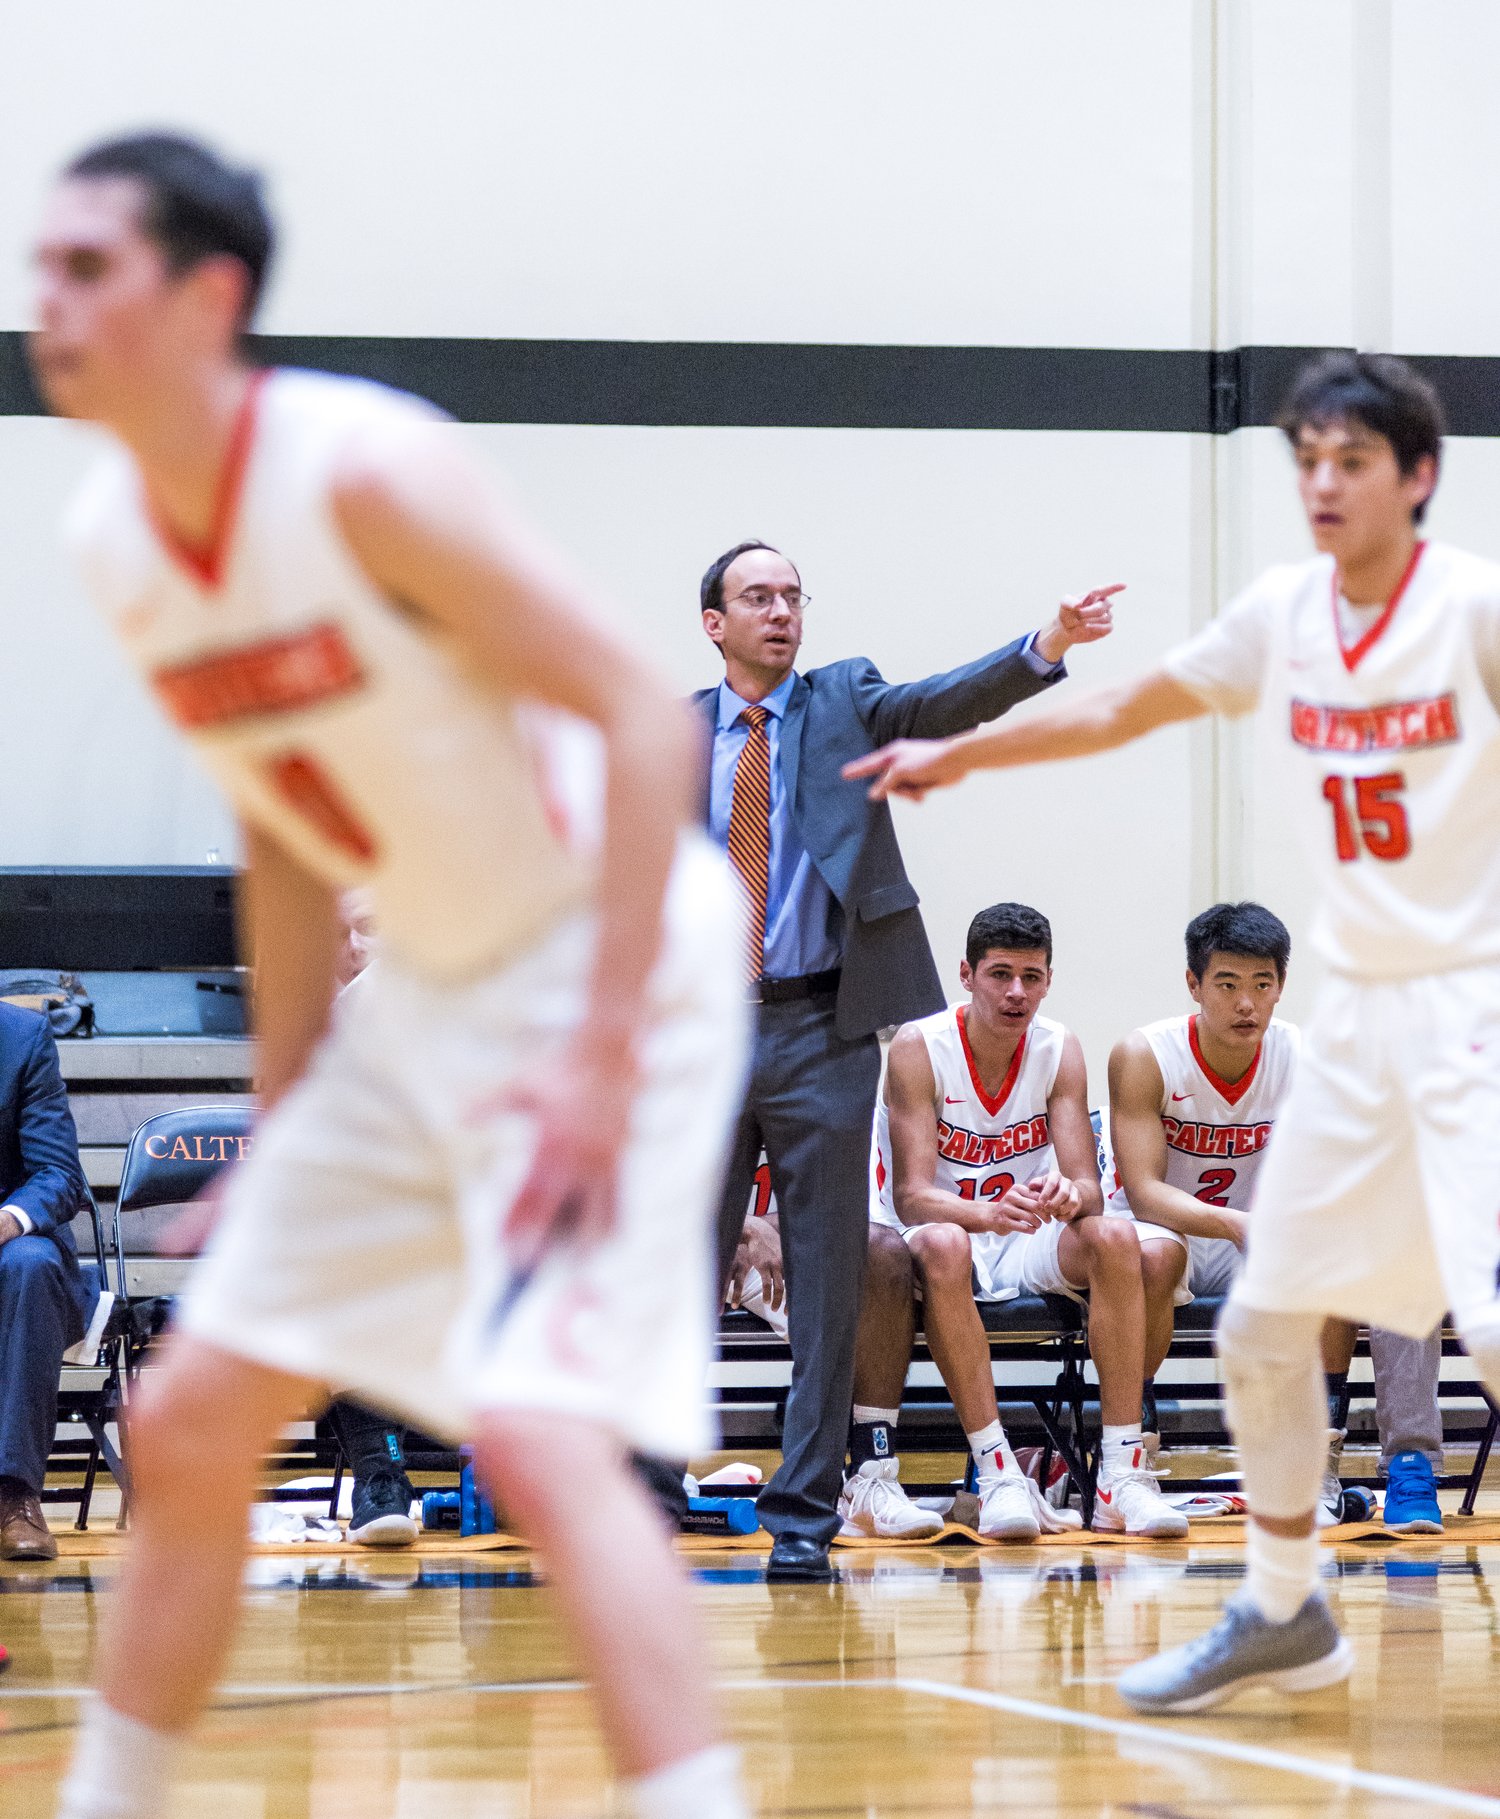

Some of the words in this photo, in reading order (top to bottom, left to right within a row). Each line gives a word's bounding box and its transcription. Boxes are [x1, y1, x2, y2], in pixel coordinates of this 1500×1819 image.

[1323, 770, 1412, 862] 15
[955, 1172, 1015, 1202] 12
[1194, 1168, 1237, 1207] 2
